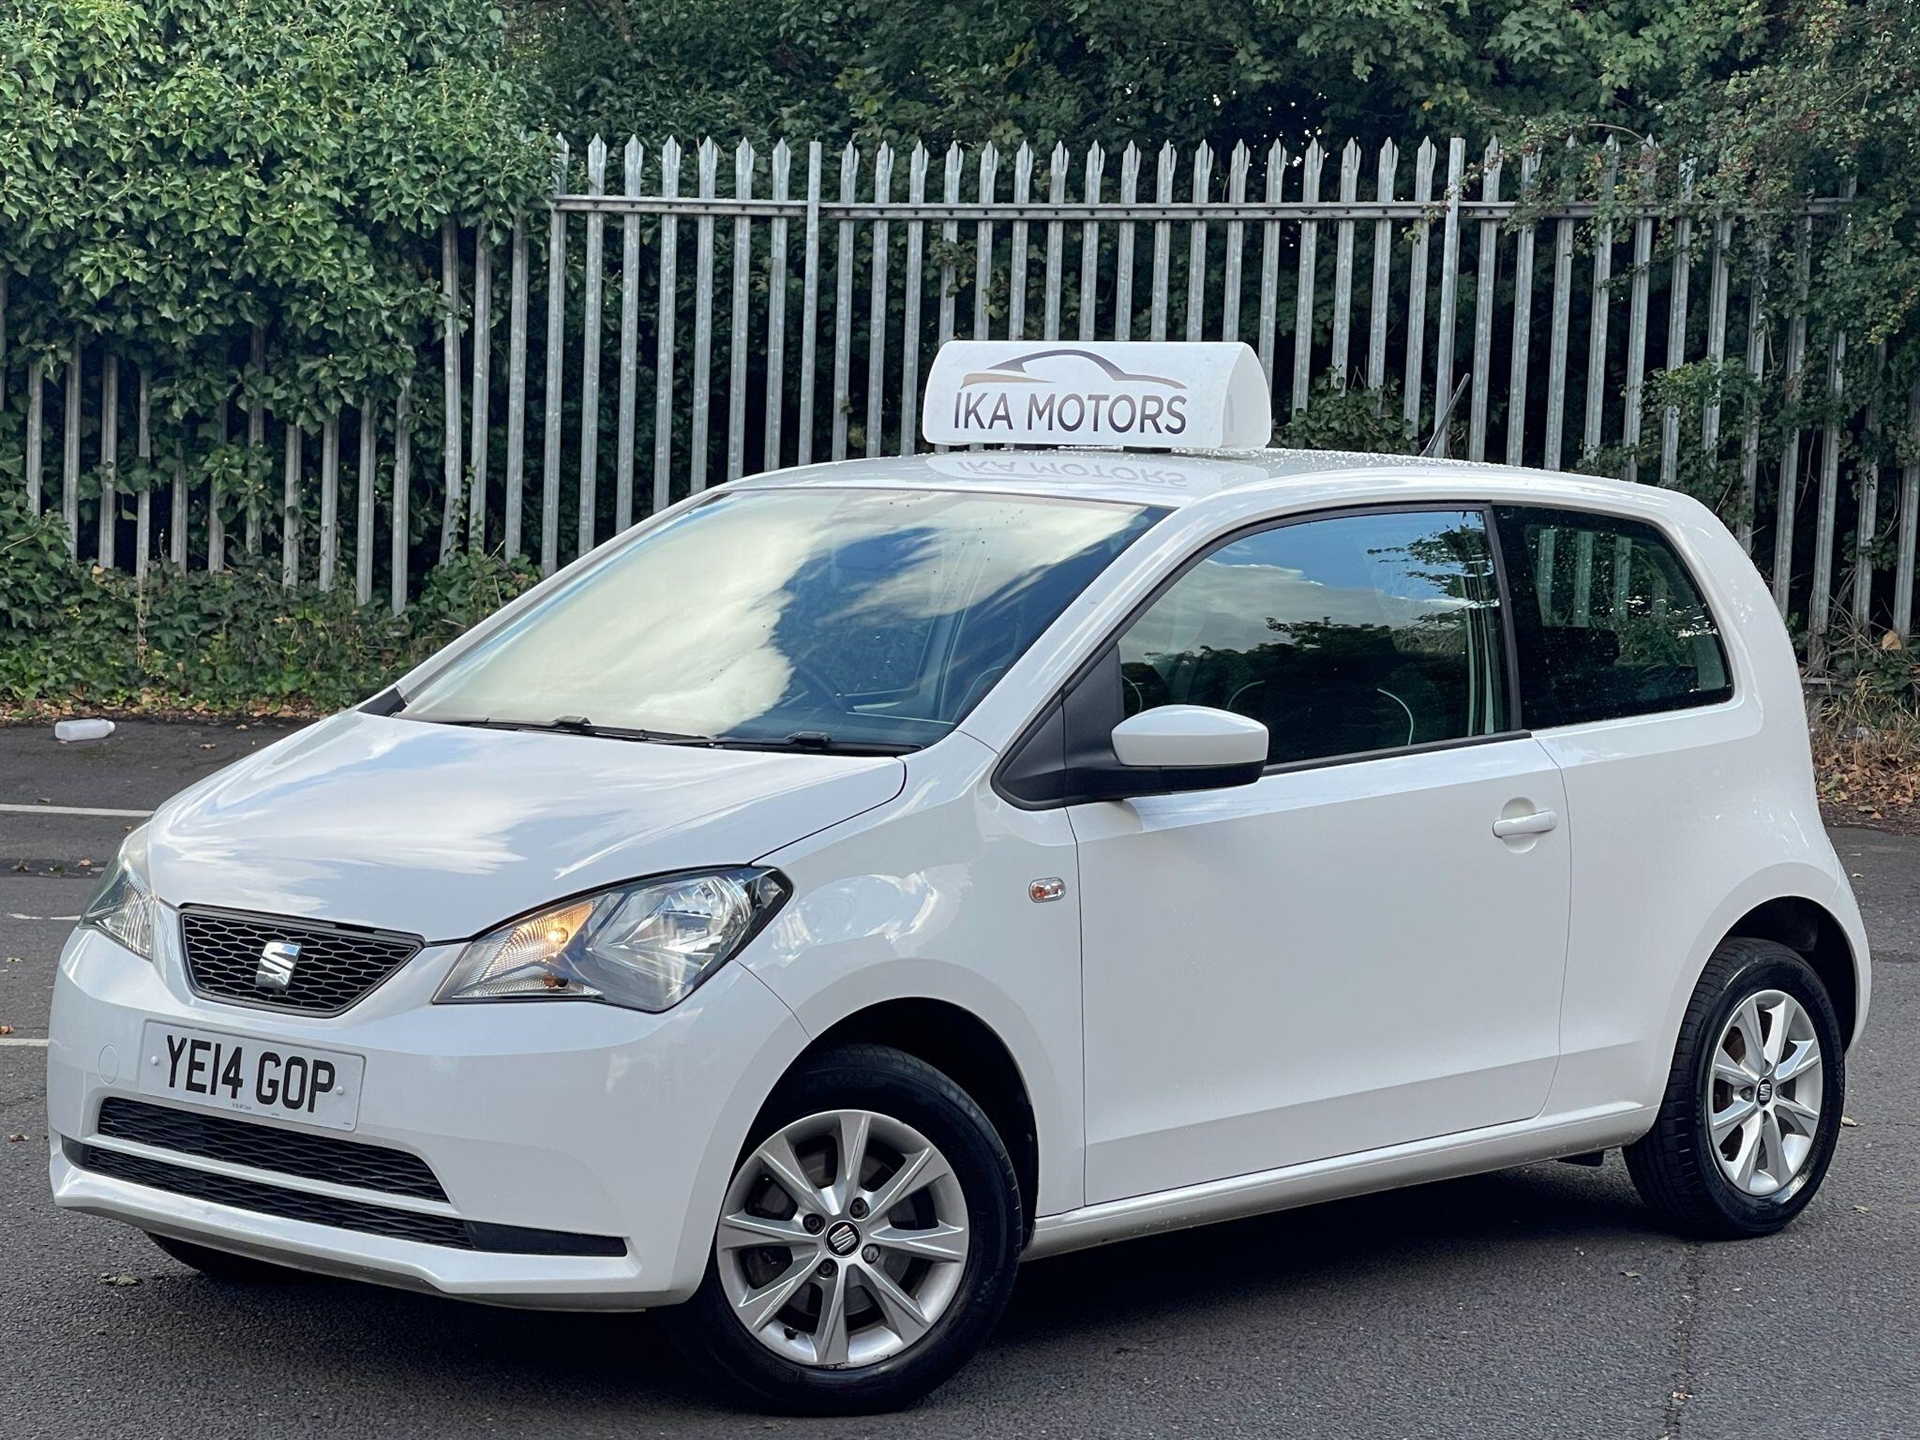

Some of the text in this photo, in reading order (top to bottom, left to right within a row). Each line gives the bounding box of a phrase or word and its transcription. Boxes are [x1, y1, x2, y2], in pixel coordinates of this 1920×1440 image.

[953, 391, 1188, 434] IKA MOTORS
[166, 1034, 336, 1114] YE14 GOP
